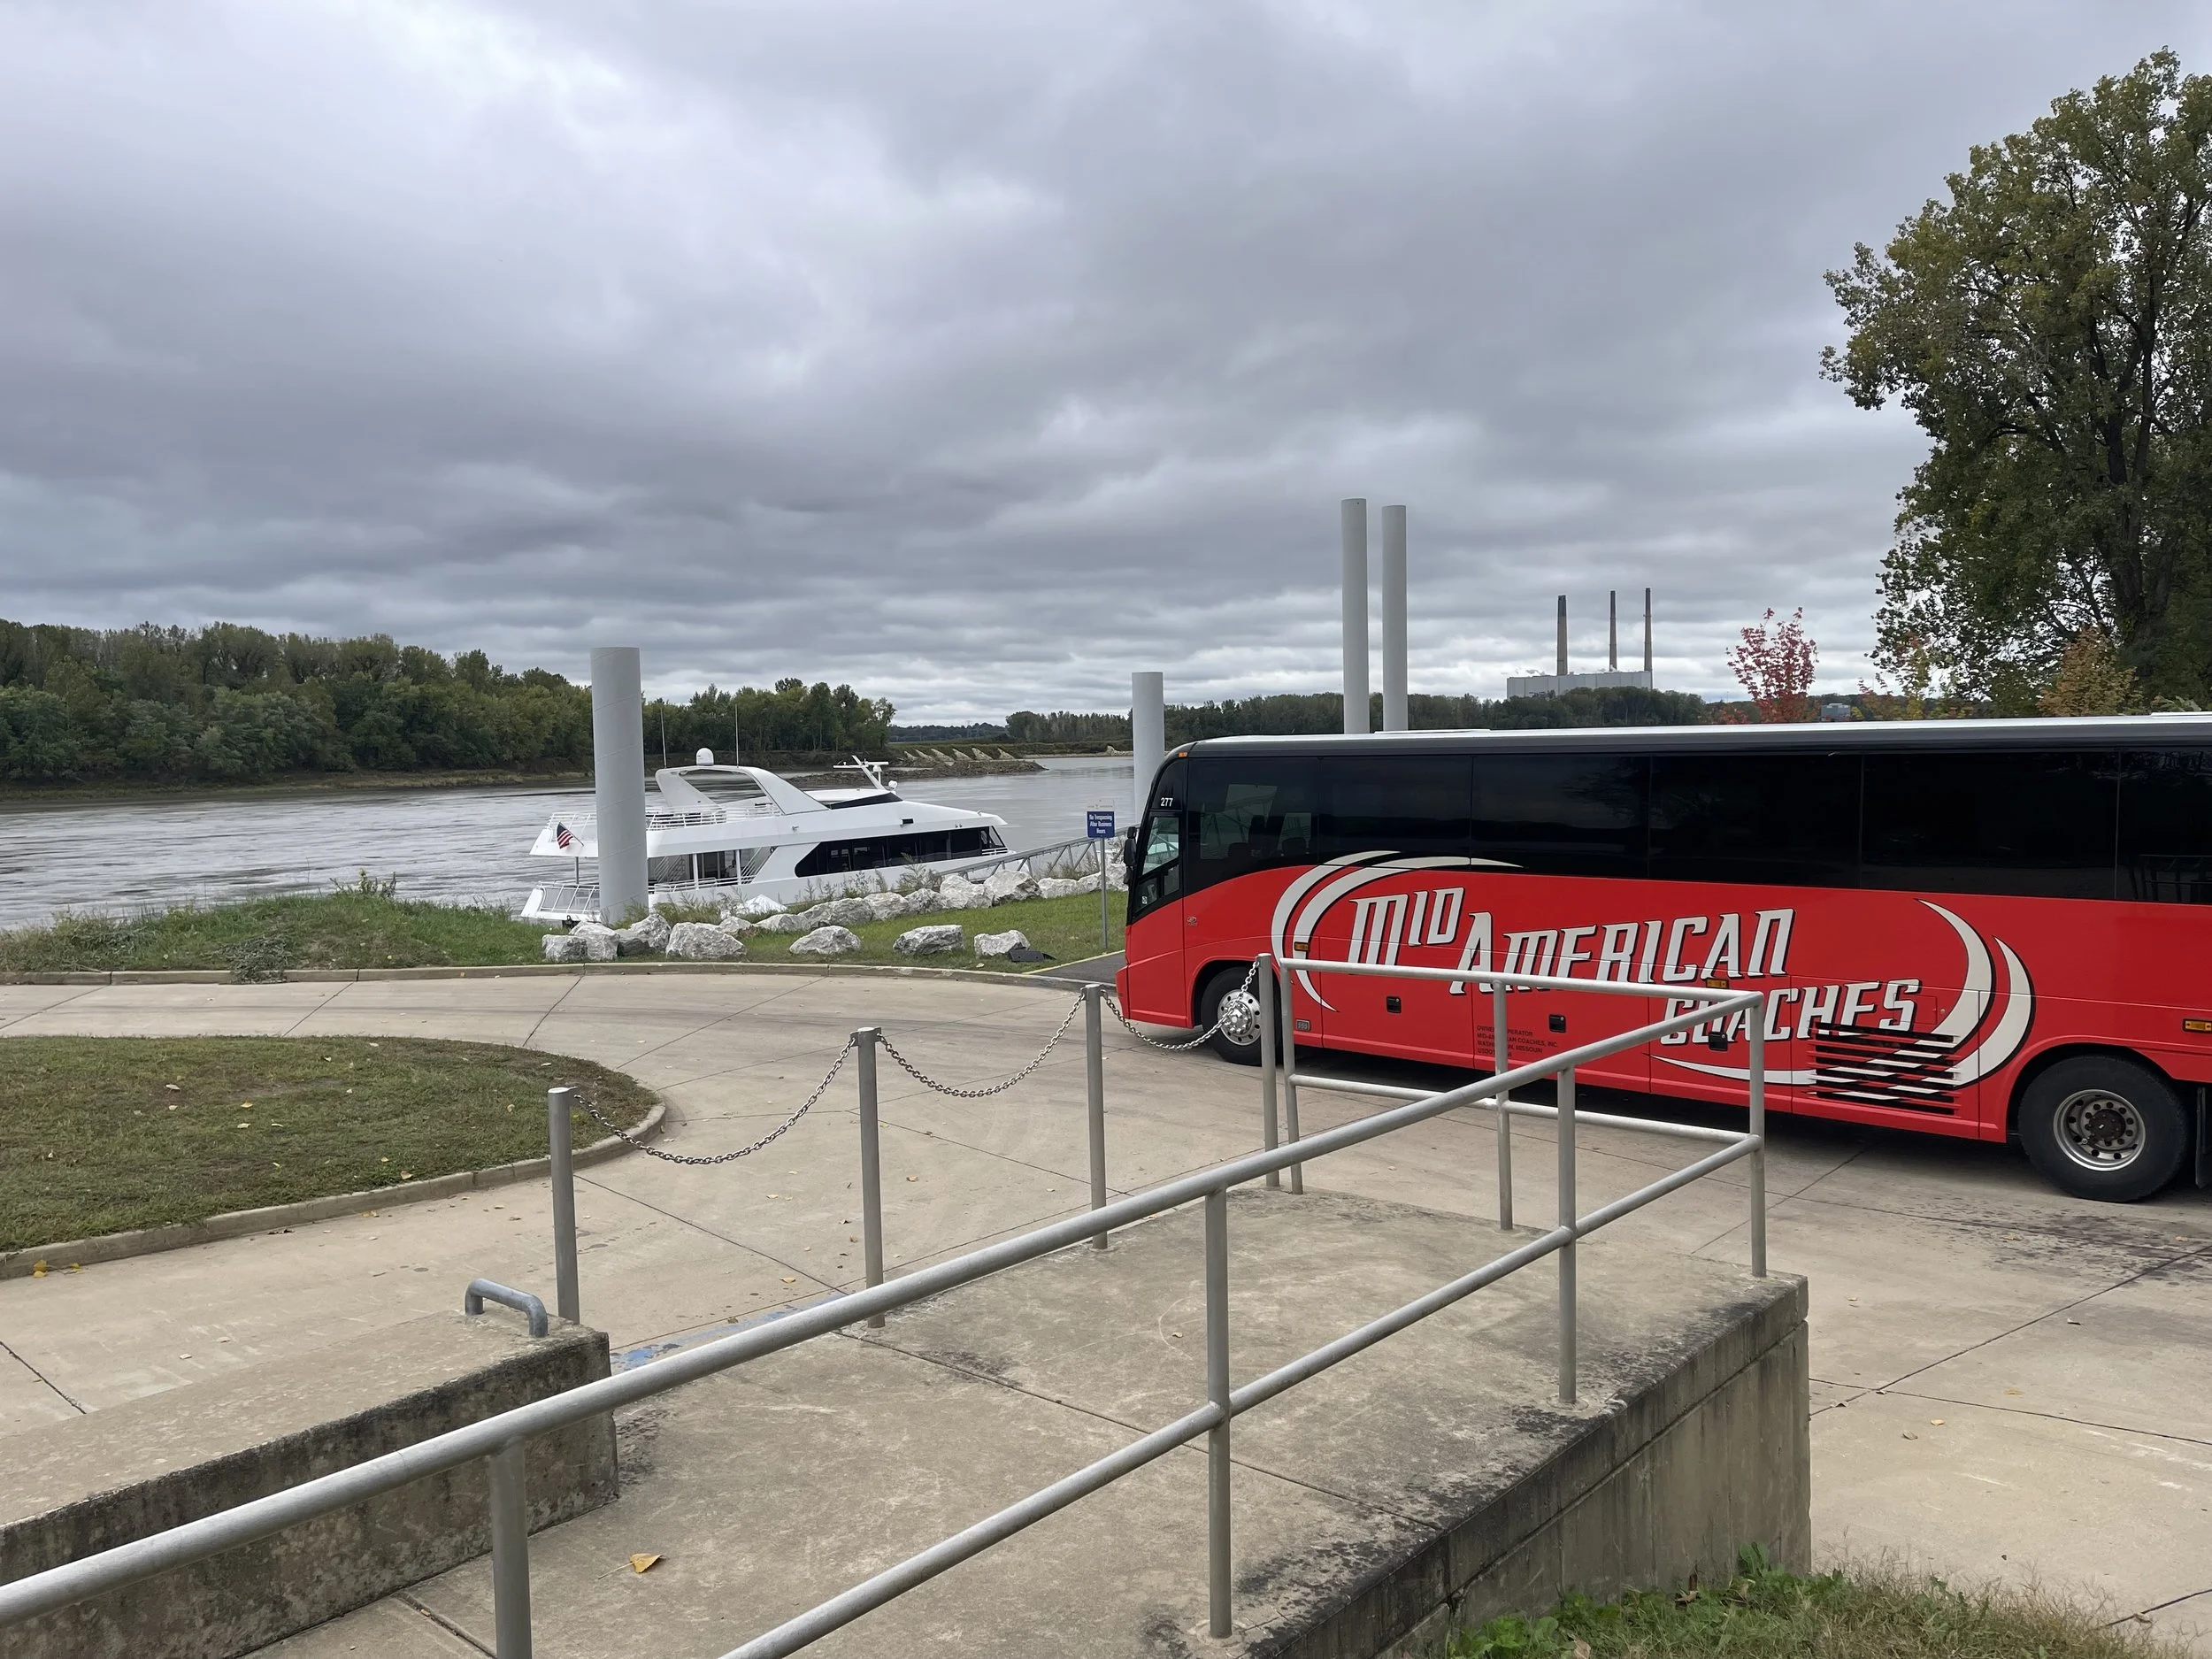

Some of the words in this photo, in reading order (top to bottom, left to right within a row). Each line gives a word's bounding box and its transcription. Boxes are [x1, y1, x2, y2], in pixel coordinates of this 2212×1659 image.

[1160, 797, 1173, 807] 277
[1348, 887, 1465, 975] MID
[1448, 908, 1795, 995] AMERICAN
[1660, 979, 1922, 1046] COACHES
[1478, 1033, 1517, 1042] MID-AAN
